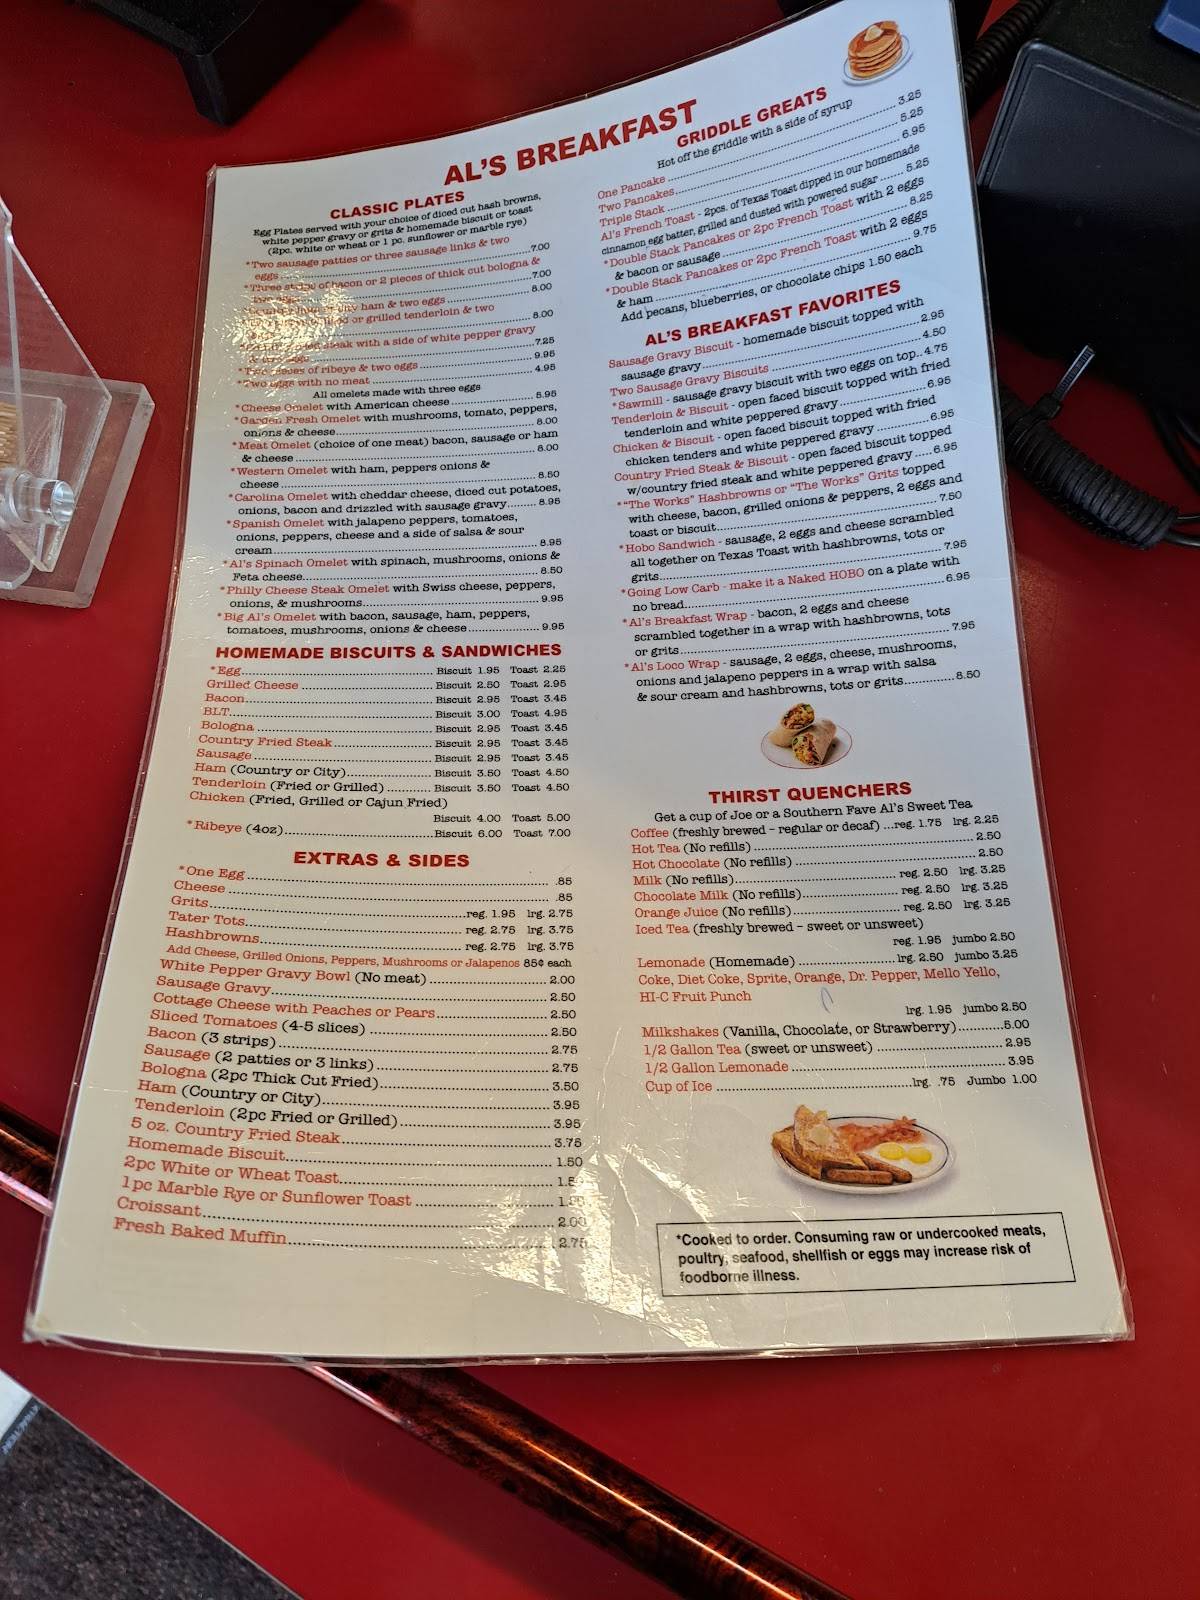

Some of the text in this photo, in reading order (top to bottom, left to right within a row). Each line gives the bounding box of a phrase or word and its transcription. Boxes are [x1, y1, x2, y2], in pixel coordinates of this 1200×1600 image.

[676, 86, 827, 148] GRIDDLE GREATS
[443, 99, 699, 187] AL'S BREAKFAST
[597, 88, 922, 200] One Pancake 3.25
[656, 98, 853, 169] Hot off the griddle with a side of syrup
[597, 105, 924, 213] Two Pancakes 5.25
[329, 190, 465, 219] CLASSIC PLATES
[252, 228, 272, 238] Egg
[273, 227, 303, 236] Plates
[305, 223, 338, 234] served
[339, 221, 362, 230] with
[363, 219, 387, 230] your
[387, 214, 419, 225] choice
[420, 211, 431, 221] of
[432, 207, 458, 219] diced
[459, 204, 476, 214] cut
[477, 200, 501, 211] hash
[645, 279, 901, 346] AL'S BREAKFAST FAVORITES
[608, 355, 654, 368] Sausage
[656, 349, 691, 361] Gravy
[694, 340, 733, 355] Biscuit
[742, 325, 807, 346] homemade
[808, 315, 850, 332] biscuit
[851, 303, 894, 323] topped
[895, 296, 925, 312] with
[609, 325, 947, 397] Two Sausage Gravy Biscuits 4.50
[312, 383, 481, 399] All omelets made with three eggs
[215, 643, 562, 659] HOMEMADE BISCUITS & SANDWICHES
[206, 679, 567, 690] Grilled Cheese Biscuit 2.50 Toast 2.95
[635, 657, 937, 687] onions and jalapeno peppers in a wrap with salsa
[189, 790, 245, 803] Chicken
[298, 795, 345, 807] Grilled
[347, 798, 363, 807] or
[365, 797, 403, 809] Cajun
[407, 797, 448, 810] Fried)
[708, 781, 912, 804] THIRST QUENCHERS
[654, 799, 973, 823] Get a cup of Joe or a Southern Fave Al's Sweet Tea
[293, 851, 470, 868] EXTRAS & SIDES
[168, 910, 574, 936] Tater Tots reg. 2.75 lrg. 3.75
[638, 965, 1000, 986] Coke, Diet Coke, Sprite, Orange, Dr. Pepper, Mello Yello,
[153, 991, 577, 1019] Cottage Cheese with Peaches or Pears 2.50
[642, 1026, 719, 1038] Milkshakes
[782, 1021, 852, 1036] Chocolate,
[855, 1025, 870, 1035] or
[873, 1020, 957, 1035] Strawberry)
[123, 1154, 339, 1184] 2pc White or Wheat Toast
[113, 1216, 287, 1245] Fresh Baked Muffin
[735, 1233, 750, 1245] to
[752, 1232, 791, 1245] order.
[794, 1230, 869, 1245] Consuming
[872, 1231, 895, 1241] raw
[898, 1230, 913, 1240] or
[916, 1225, 999, 1240] undercooked
[1002, 1224, 1046, 1237] meats,
[791, 1248, 847, 1262] shellfish
[850, 1250, 865, 1260] or
[867, 1249, 900, 1263] eggs
[903, 1248, 930, 1261] may
[933, 1245, 988, 1257] increase
[990, 1242, 1015, 1255] risk
[1018, 1241, 1031, 1254] of
[679, 1269, 800, 1284] foodborne illness.
